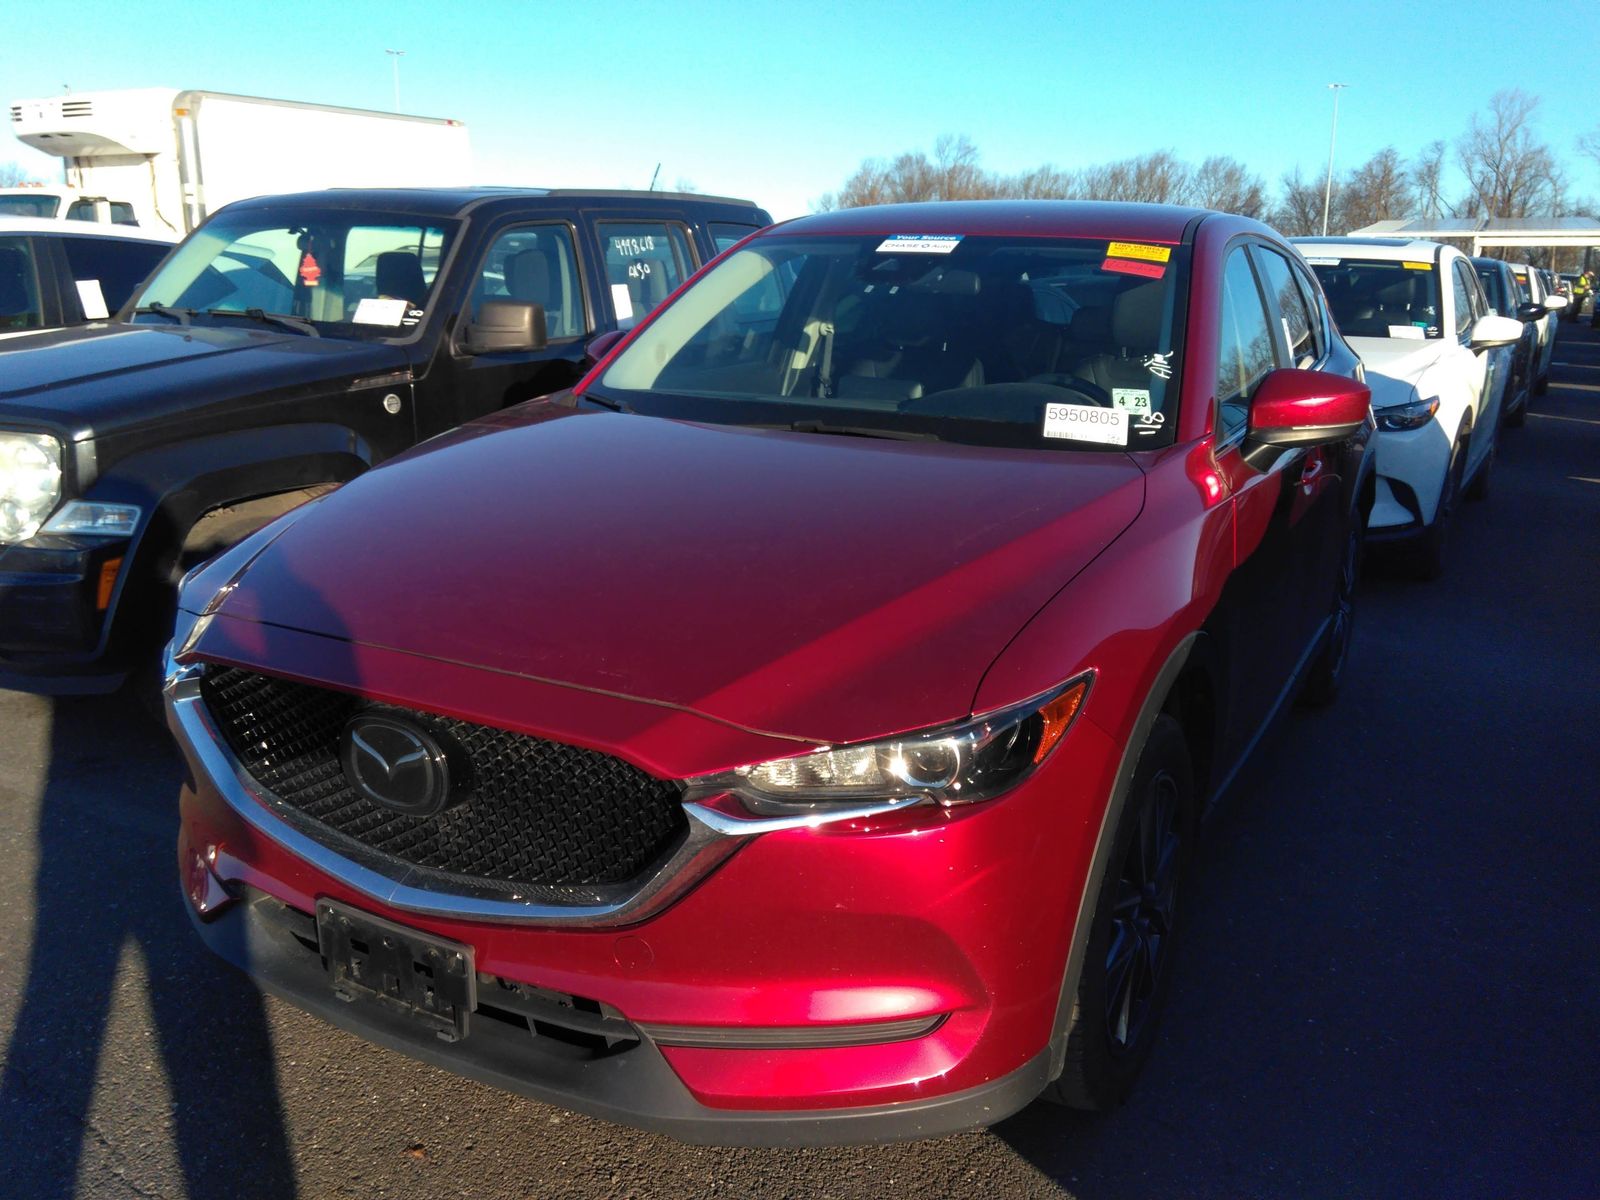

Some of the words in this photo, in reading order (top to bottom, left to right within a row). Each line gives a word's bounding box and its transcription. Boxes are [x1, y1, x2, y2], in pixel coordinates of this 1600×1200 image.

[1118, 396, 1127, 406] 4
[1134, 397, 1148, 408] 23
[1048, 407, 1120, 426] 5950805
